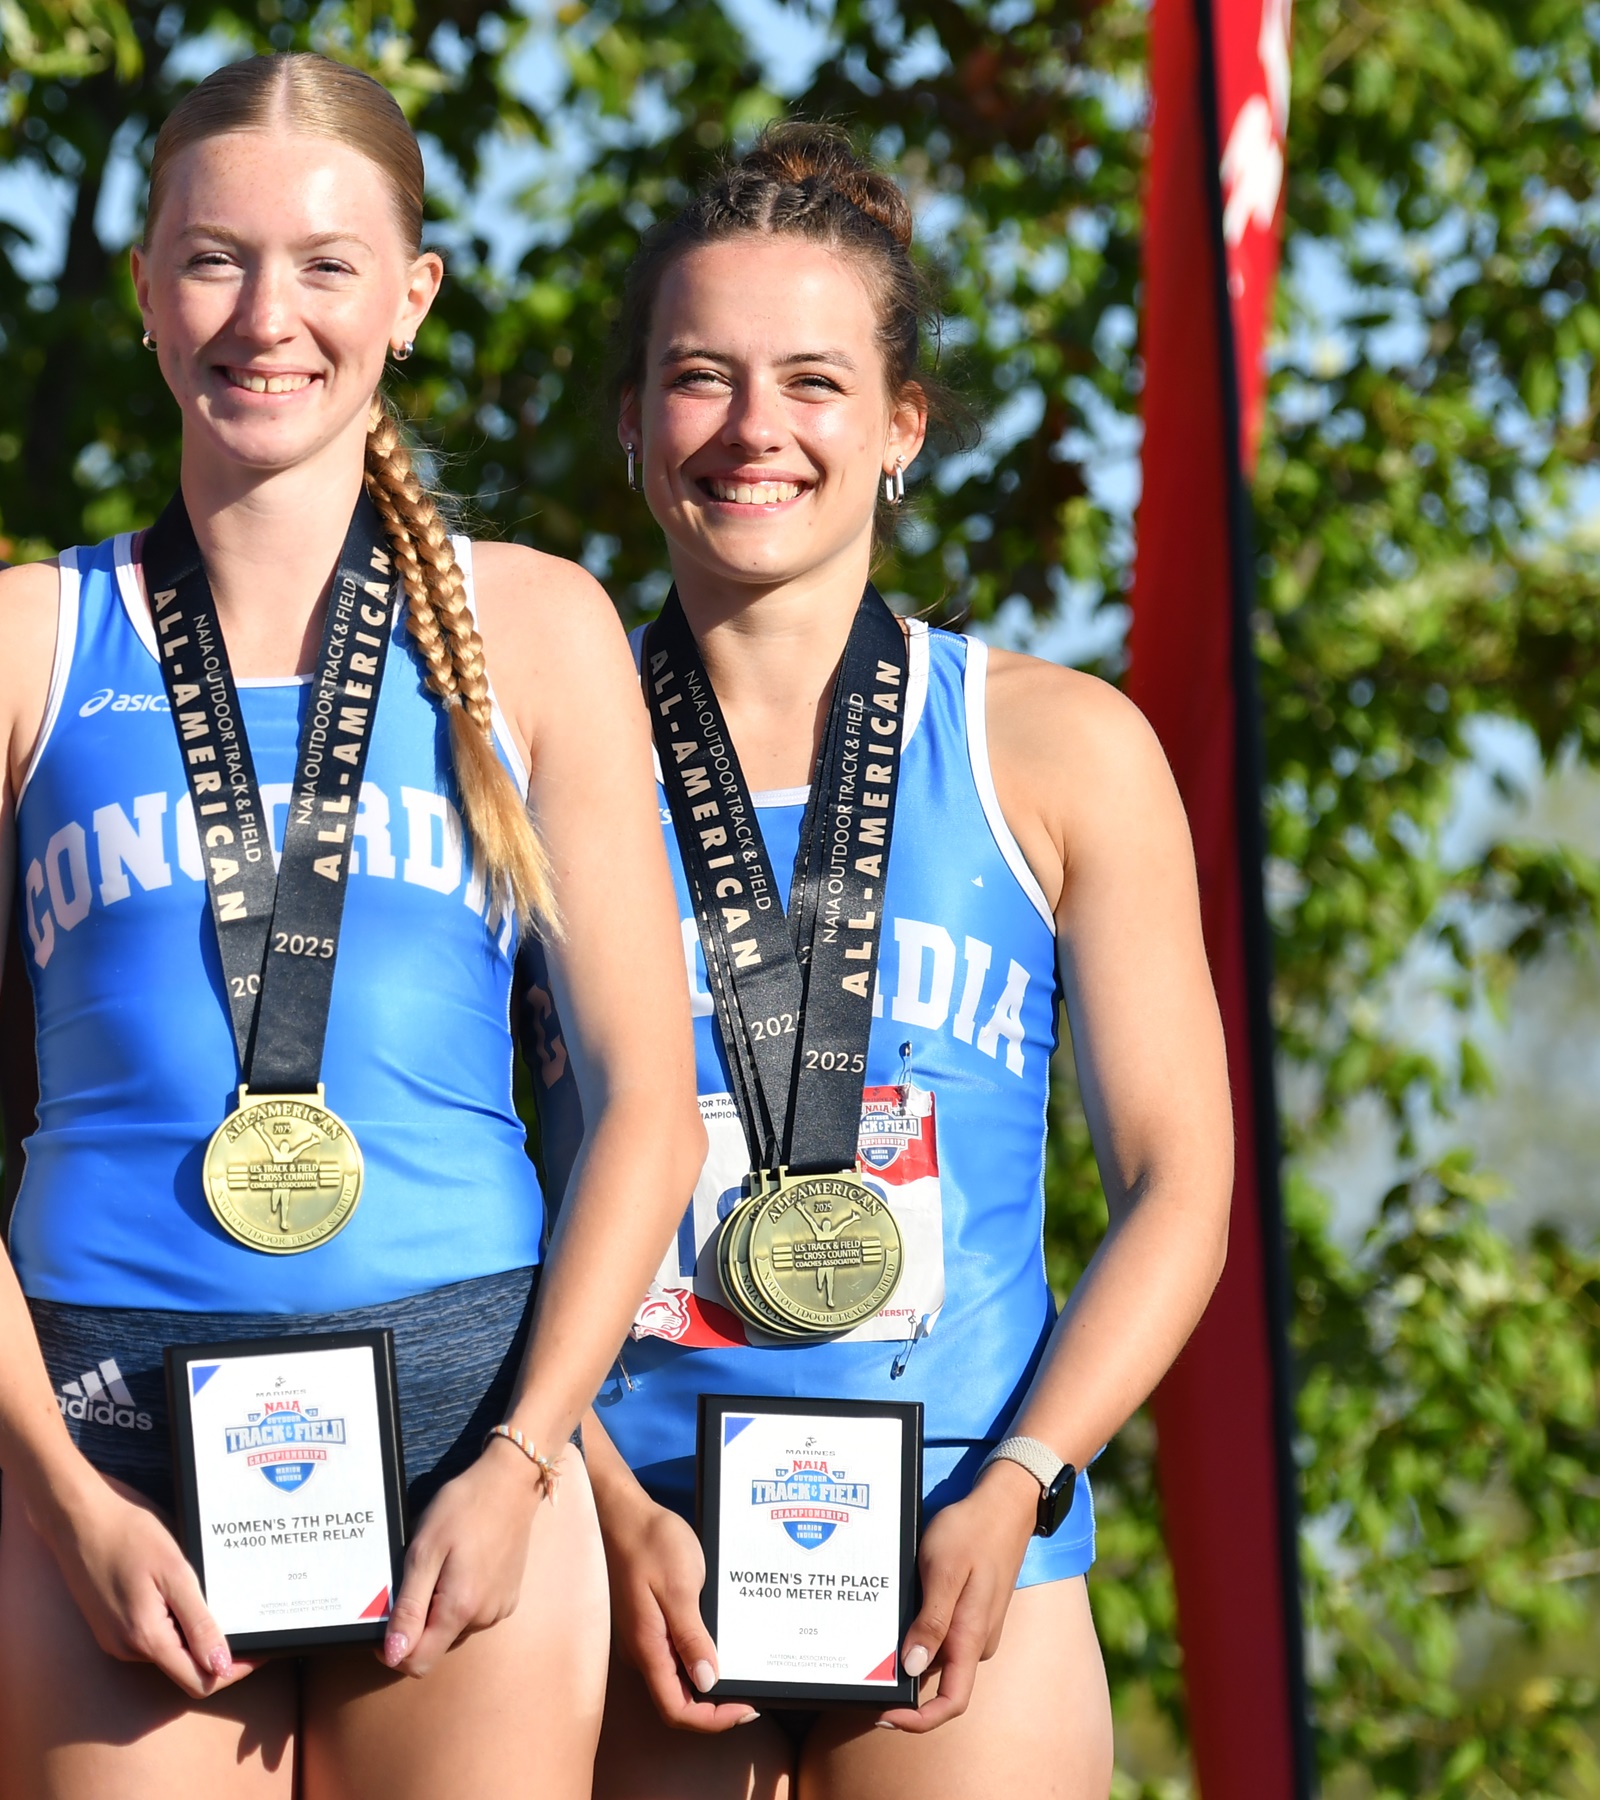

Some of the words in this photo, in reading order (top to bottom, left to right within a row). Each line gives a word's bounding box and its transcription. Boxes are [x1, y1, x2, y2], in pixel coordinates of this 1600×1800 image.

[336, 577, 357, 620] FIELD
[193, 614, 215, 656] NAIA
[333, 622, 348, 635] &
[321, 635, 345, 688] TRACK
[204, 657, 236, 742] OUTDOOR
[684, 669, 707, 712] NAIA
[313, 546, 391, 882] ALL-AMERICAN
[846, 692, 865, 736] FIELD
[304, 690, 335, 779] OUTDOOR
[845, 736, 860, 749] &
[154, 588, 247, 922] ALL-AMERICAN
[224, 742, 248, 797] TRACK
[700, 711, 738, 796] OUTDOOR
[839, 752, 859, 802] TRACK
[235, 799, 251, 811] &
[296, 781, 317, 825] NAIA
[651, 650, 761, 968] ALL-AMERICAN
[239, 813, 261, 862] FIELD
[726, 795, 755, 848] TRACK
[843, 660, 901, 999] ALL-AMERICAN
[742, 851, 758, 863] &
[828, 805, 852, 894] OUTDOOR
[747, 864, 772, 910] FIELD
[823, 898, 842, 943] NAIA
[274, 933, 335, 959] 2025
[751, 1012, 801, 1041] 202
[805, 1050, 865, 1073] 2025
[226, 1103, 342, 1143] ALL-AMERICAN
[768, 1182, 882, 1224] ALL-AMERICAN
[814, 1202, 832, 1212] 2025
[803, 1251, 827, 1260] CROSS
[828, 1249, 860, 1259] COUNTRY
[807, 1242, 831, 1251] TRACK
[841, 1240, 860, 1249] FIELD
[795, 1260, 821, 1268] COACHES
[823, 1258, 860, 1267] ASSOCIATION
[264, 1401, 301, 1415] NAIA
[227, 1425, 284, 1450] TRACK
[294, 1421, 343, 1443] FIELD
[249, 1450, 326, 1466] CHAMPIONSHIPS
[793, 1460, 828, 1473] NAIA
[754, 1483, 810, 1502] TRACK
[820, 1484, 867, 1506] FIELD
[212, 1518, 286, 1535] WOMEN'S
[291, 1516, 320, 1529] 7TH
[326, 1511, 374, 1526] PLACE
[772, 1509, 848, 1521] CHAMPIONSHIPS
[223, 1535, 266, 1549] 4x400
[271, 1532, 318, 1545] METER
[323, 1528, 365, 1541] RELAY
[287, 1572, 307, 1581] 2025
[730, 1571, 802, 1585] WOMEN'S
[808, 1574, 836, 1586] 7TH
[842, 1576, 889, 1588] PLACE
[739, 1587, 782, 1599] 4x400
[786, 1589, 833, 1601] METER
[837, 1590, 879, 1602] RELAY
